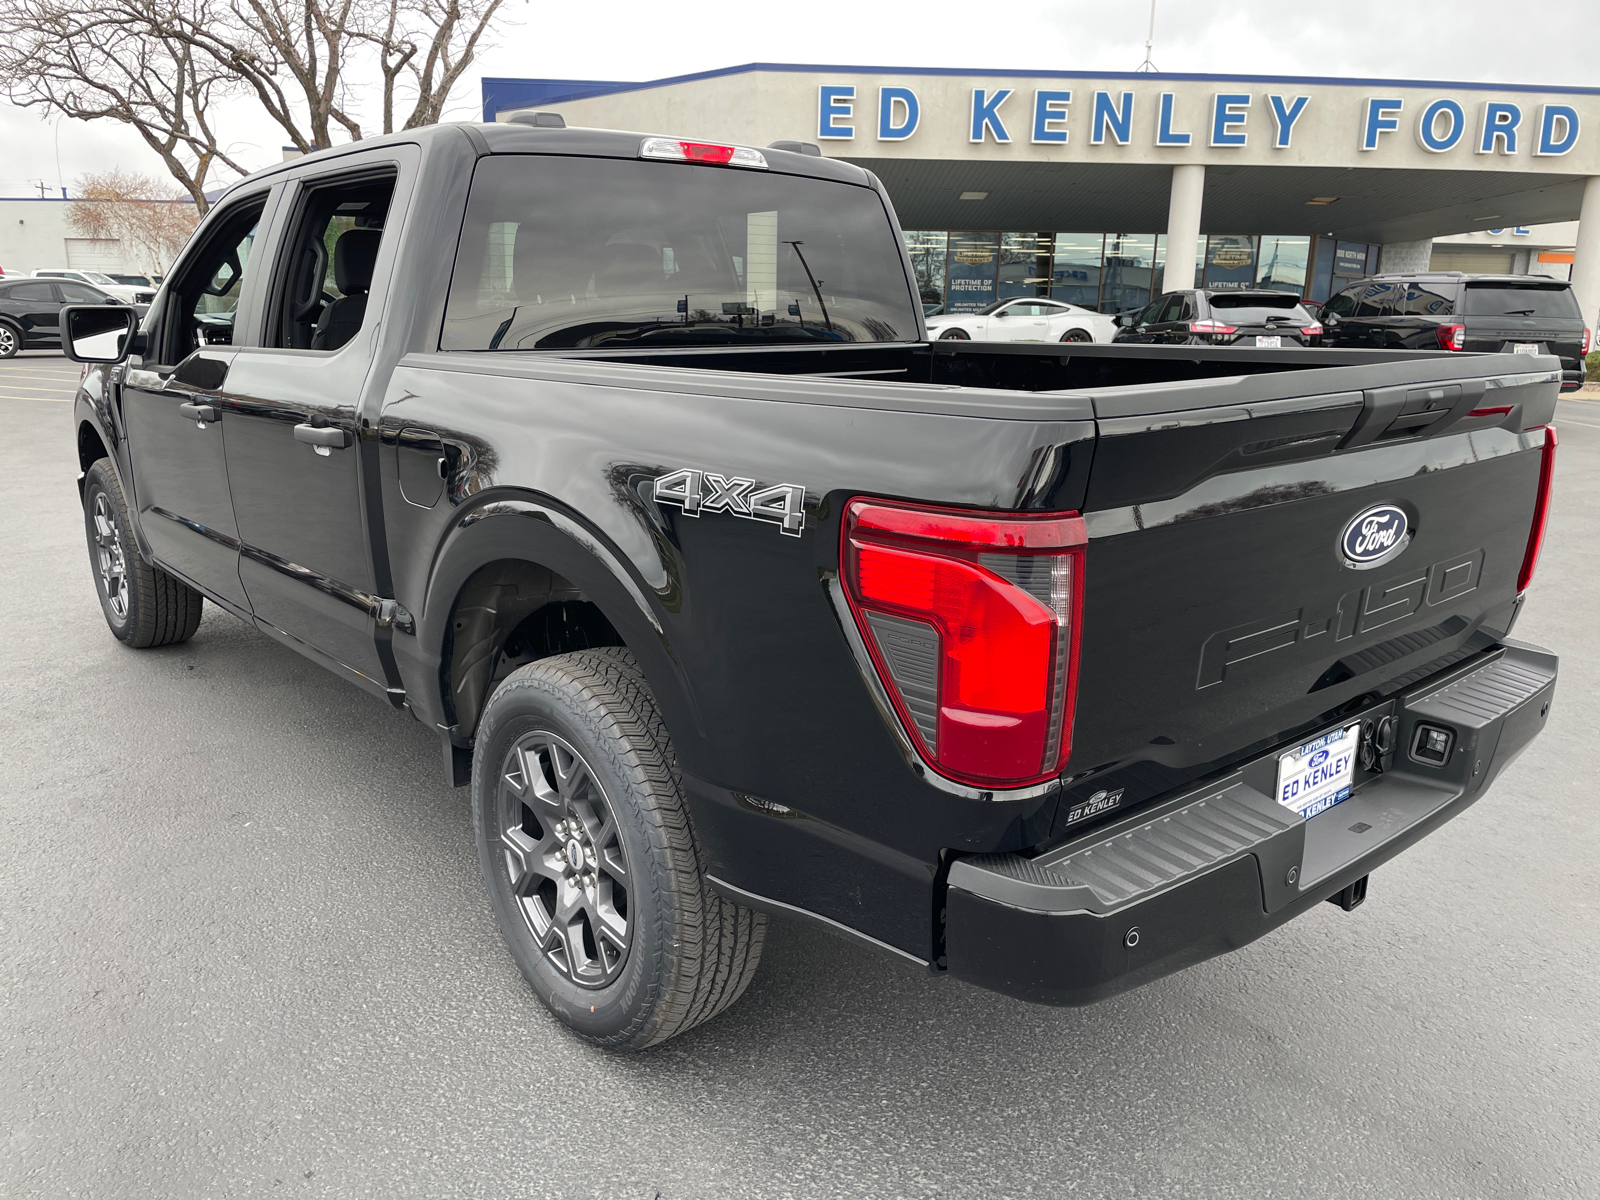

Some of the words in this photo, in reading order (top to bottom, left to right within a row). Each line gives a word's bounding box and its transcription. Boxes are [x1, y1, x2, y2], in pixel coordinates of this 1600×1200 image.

[817, 84, 921, 141] ED
[969, 87, 1312, 148] KENLEY
[1358, 96, 1581, 156] FORD
[653, 468, 806, 538] 4X4
[1354, 513, 1399, 553] Ford
[1196, 548, 1486, 690] F-150
[887, 633, 935, 650] FORD
[1327, 729, 1344, 743] UTAH
[1282, 779, 1300, 802] ED
[1303, 753, 1352, 791] KENLEY
[1067, 808, 1082, 822] ED
[1083, 792, 1123, 816] KENLEY
[1305, 792, 1337, 819] KENLEY
